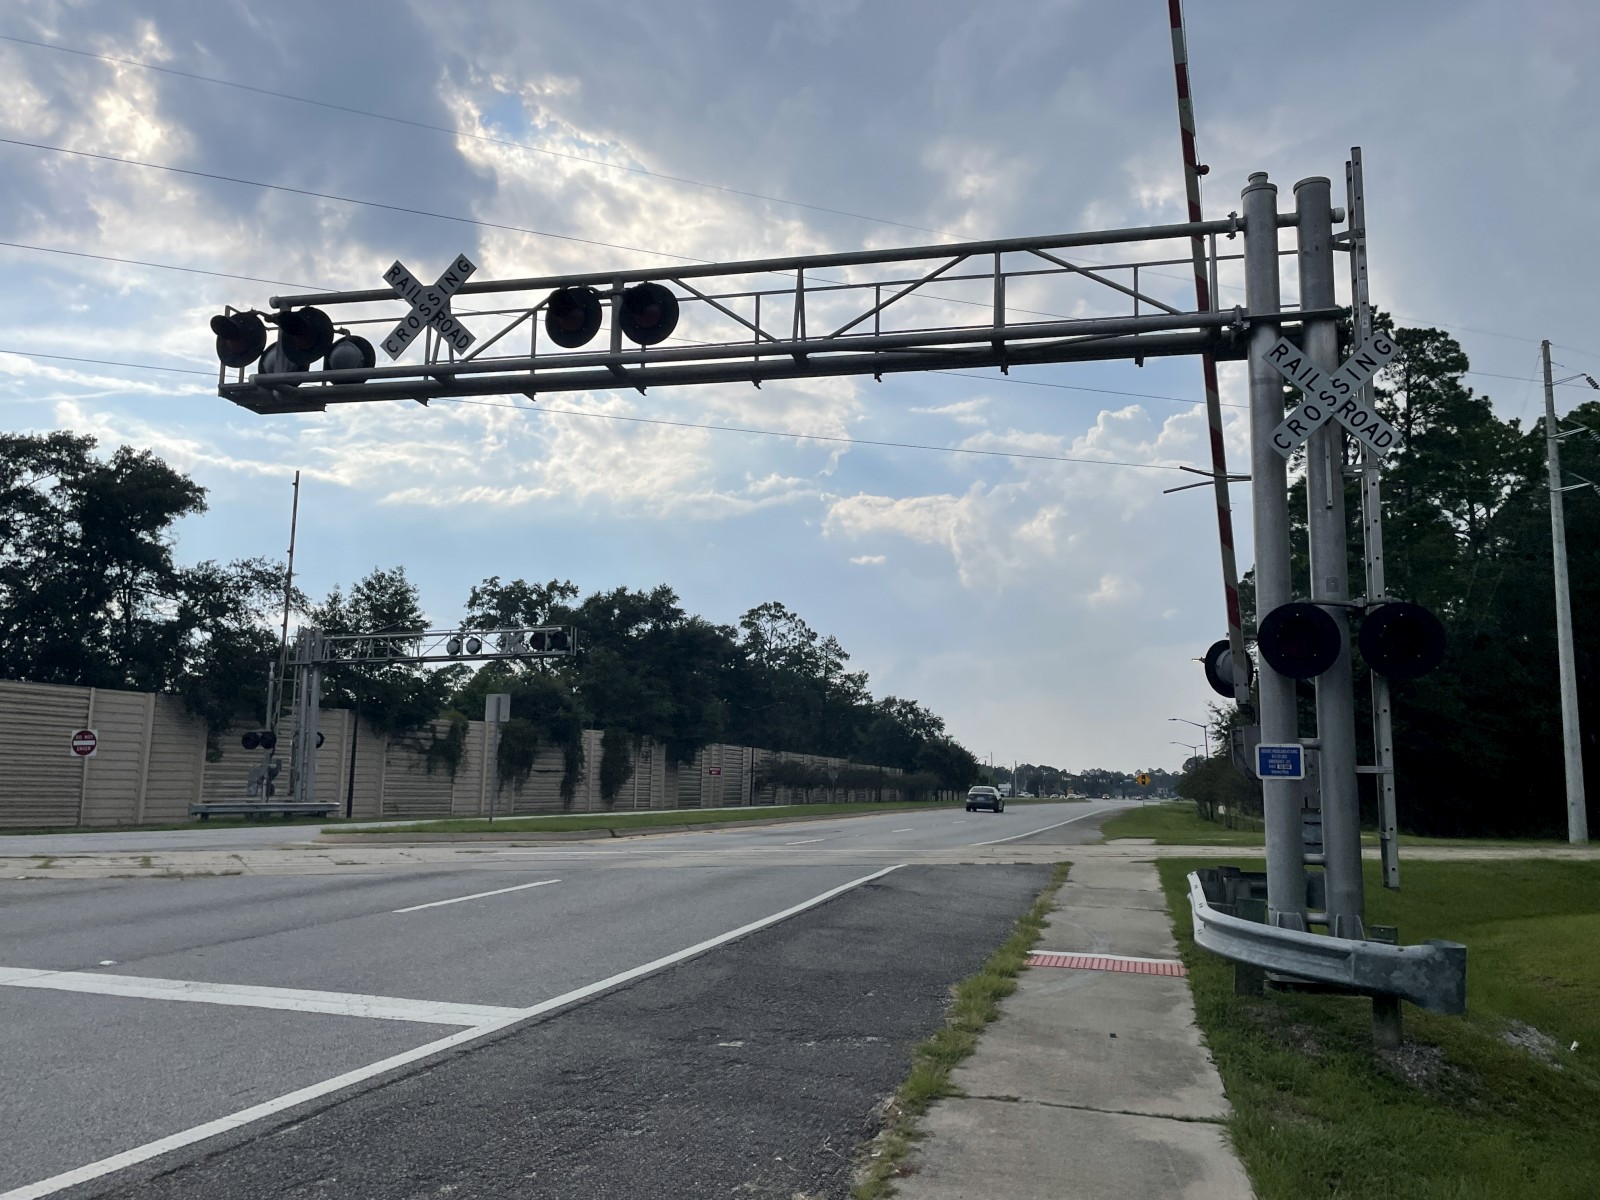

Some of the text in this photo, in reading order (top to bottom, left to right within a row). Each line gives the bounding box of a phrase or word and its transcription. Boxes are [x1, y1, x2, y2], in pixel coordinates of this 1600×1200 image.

[386, 260, 469, 353] CROSSING
[387, 266, 469, 348] RAIL ROAD
[1269, 343, 1393, 448] RAIL ROAD
[1273, 339, 1392, 449] CROSSING
